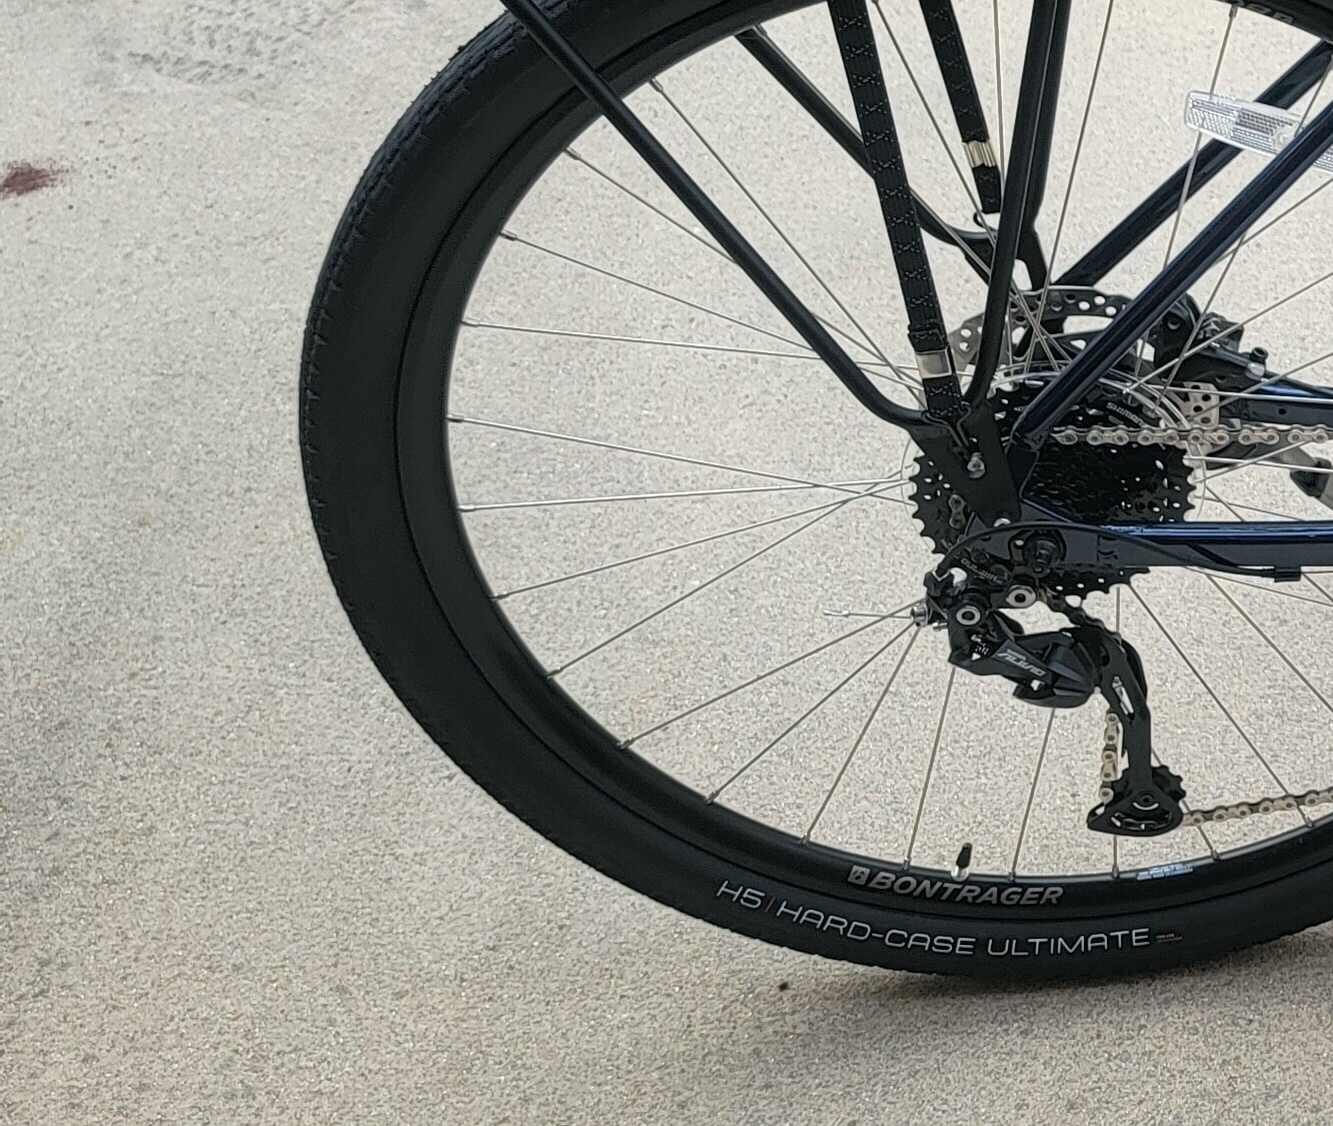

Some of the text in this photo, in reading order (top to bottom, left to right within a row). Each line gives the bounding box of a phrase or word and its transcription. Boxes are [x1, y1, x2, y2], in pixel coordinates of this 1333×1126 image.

[868, 871, 1064, 906] BONTRAGER
[716, 880, 1150, 957] H5 HARD-CASE ULTIMATE
